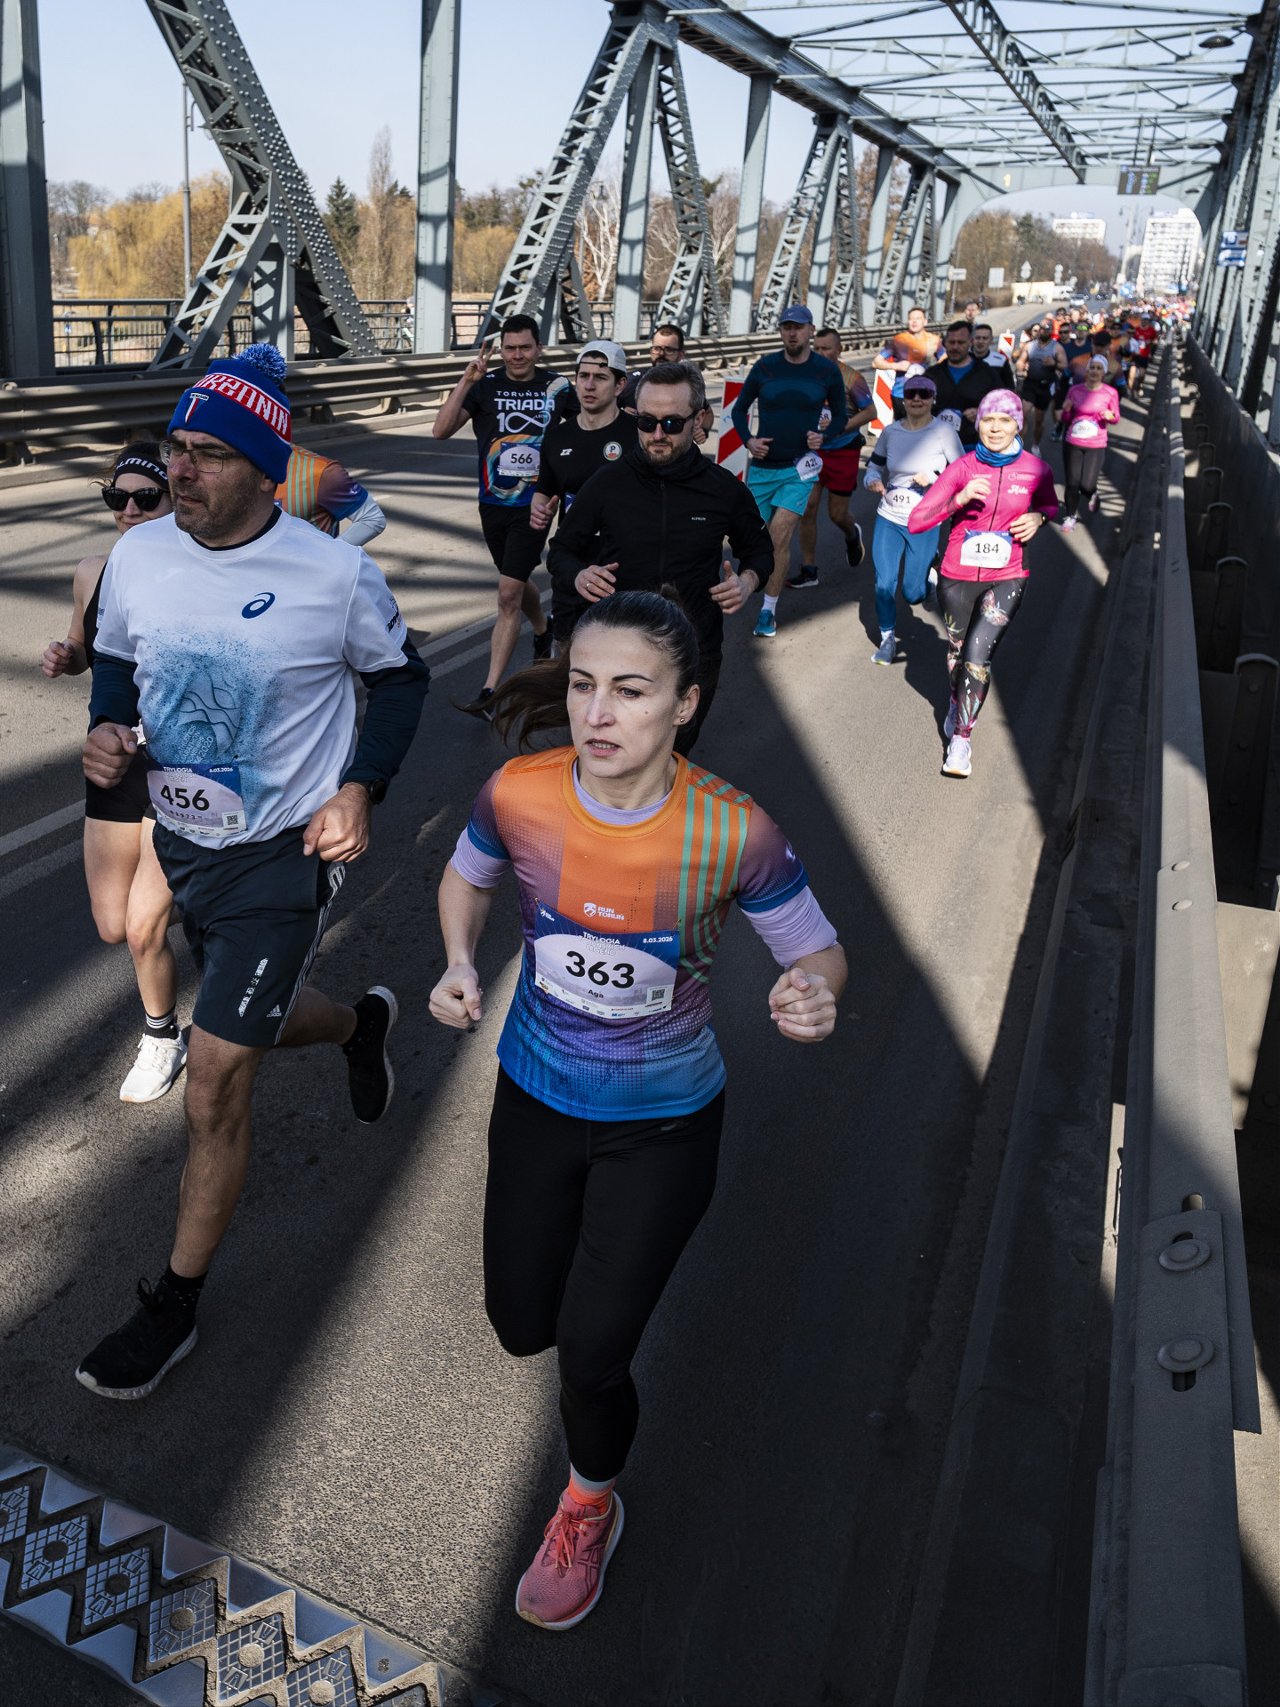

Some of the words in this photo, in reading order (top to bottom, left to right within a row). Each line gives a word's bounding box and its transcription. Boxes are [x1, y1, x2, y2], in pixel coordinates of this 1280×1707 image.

[494, 398, 556, 411] TRIADA
[511, 453, 533, 464] 566
[893, 494, 911, 504] 491
[975, 543, 999, 554] 184
[161, 785, 210, 811] 456
[598, 906, 615, 914] RUN
[583, 931, 621, 945] TRYLOGIA
[643, 936, 673, 944] 8.03.2026
[565, 950, 634, 989] 363
[587, 989, 604, 999] Aga
